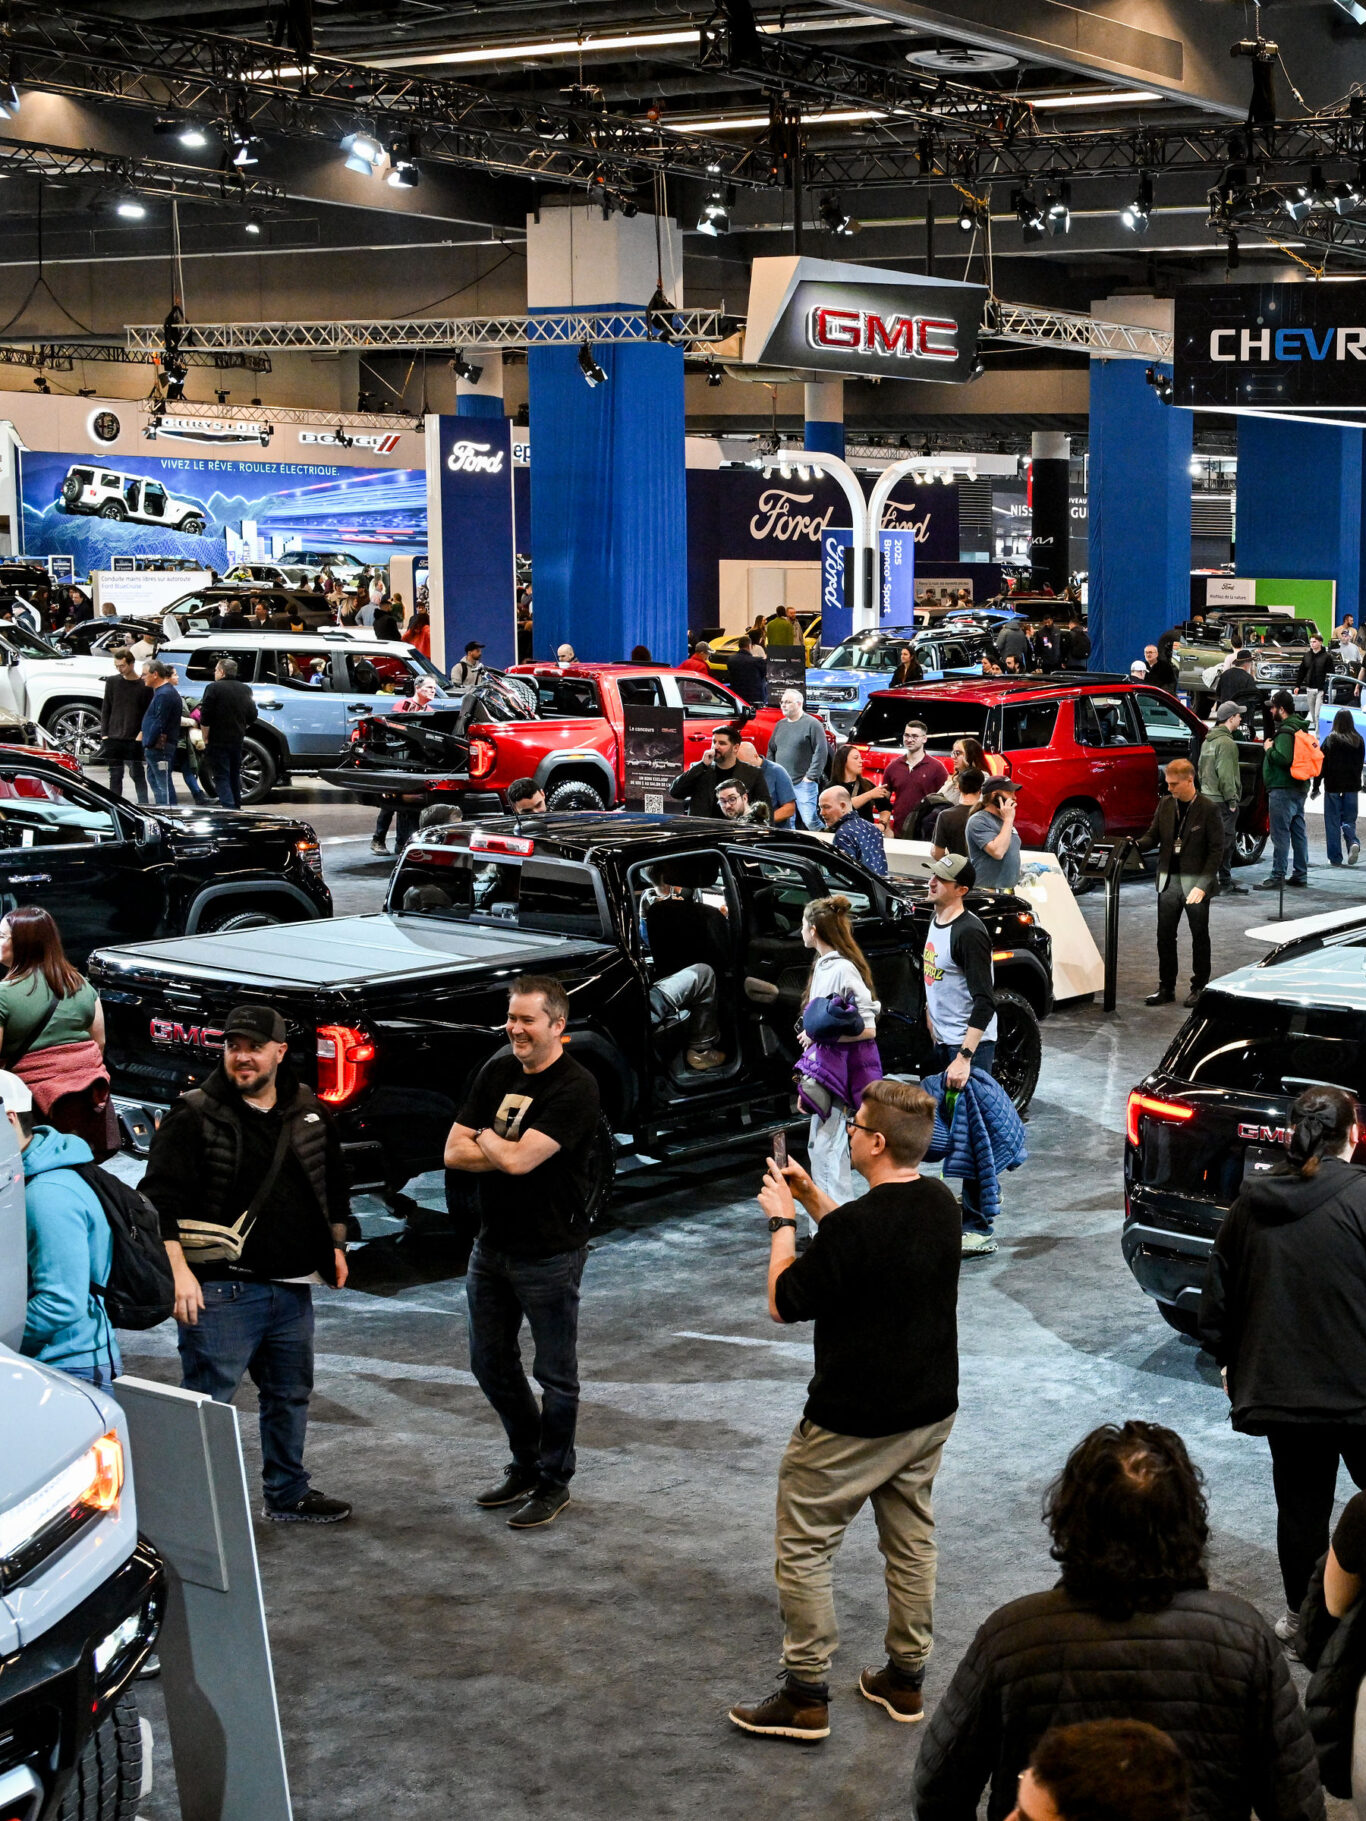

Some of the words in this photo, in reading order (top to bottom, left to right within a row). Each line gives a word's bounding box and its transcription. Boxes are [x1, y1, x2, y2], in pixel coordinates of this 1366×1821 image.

[807, 304, 959, 361] GMC
[161, 459, 190, 470] VIVEZ
[194, 461, 205, 470] LE
[208, 461, 236, 472] RÊVE.
[239, 463, 277, 473] ROULEZ
[280, 464, 341, 477] ÉLECTRIQUE.
[448, 441, 503, 473] Ford
[750, 489, 834, 542] Ford
[894, 538, 903, 566] 2025
[825, 537, 845, 609] Ford
[882, 583, 893, 613] Sport
[150, 1018, 226, 1050] GMC
